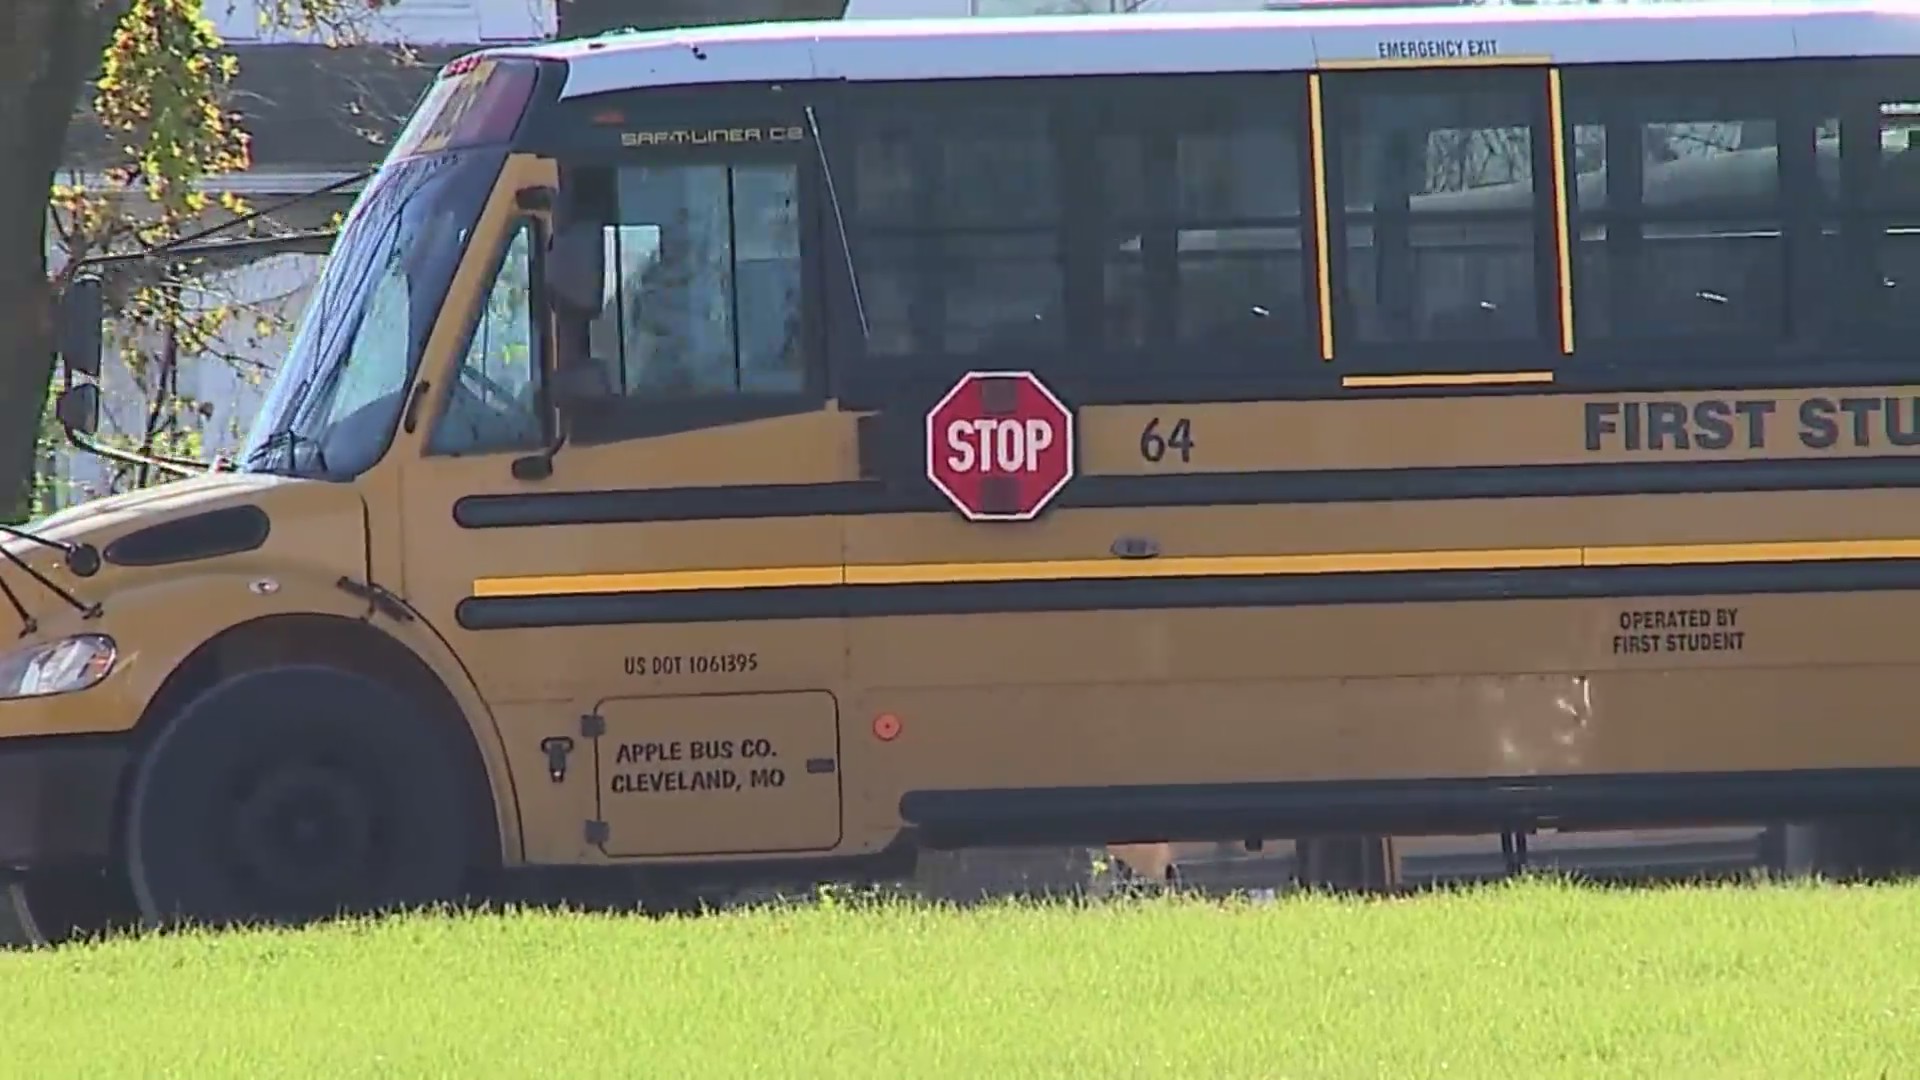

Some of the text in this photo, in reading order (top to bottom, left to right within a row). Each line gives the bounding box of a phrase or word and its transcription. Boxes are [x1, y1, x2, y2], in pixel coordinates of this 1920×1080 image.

[1378, 39, 1498, 58] EMERGENCY EXIT
[1585, 396, 1920, 450] FIRST STU
[948, 419, 1052, 472] STOP
[1140, 417, 1194, 463] 64
[1619, 608, 1738, 630] OPERATED BY
[1613, 632, 1744, 653] FIRST STUDENT
[624, 653, 758, 675] US DOT 1061395
[616, 739, 777, 763] APPLE BUS CO.
[611, 768, 785, 793] CLEVELAND, MO
